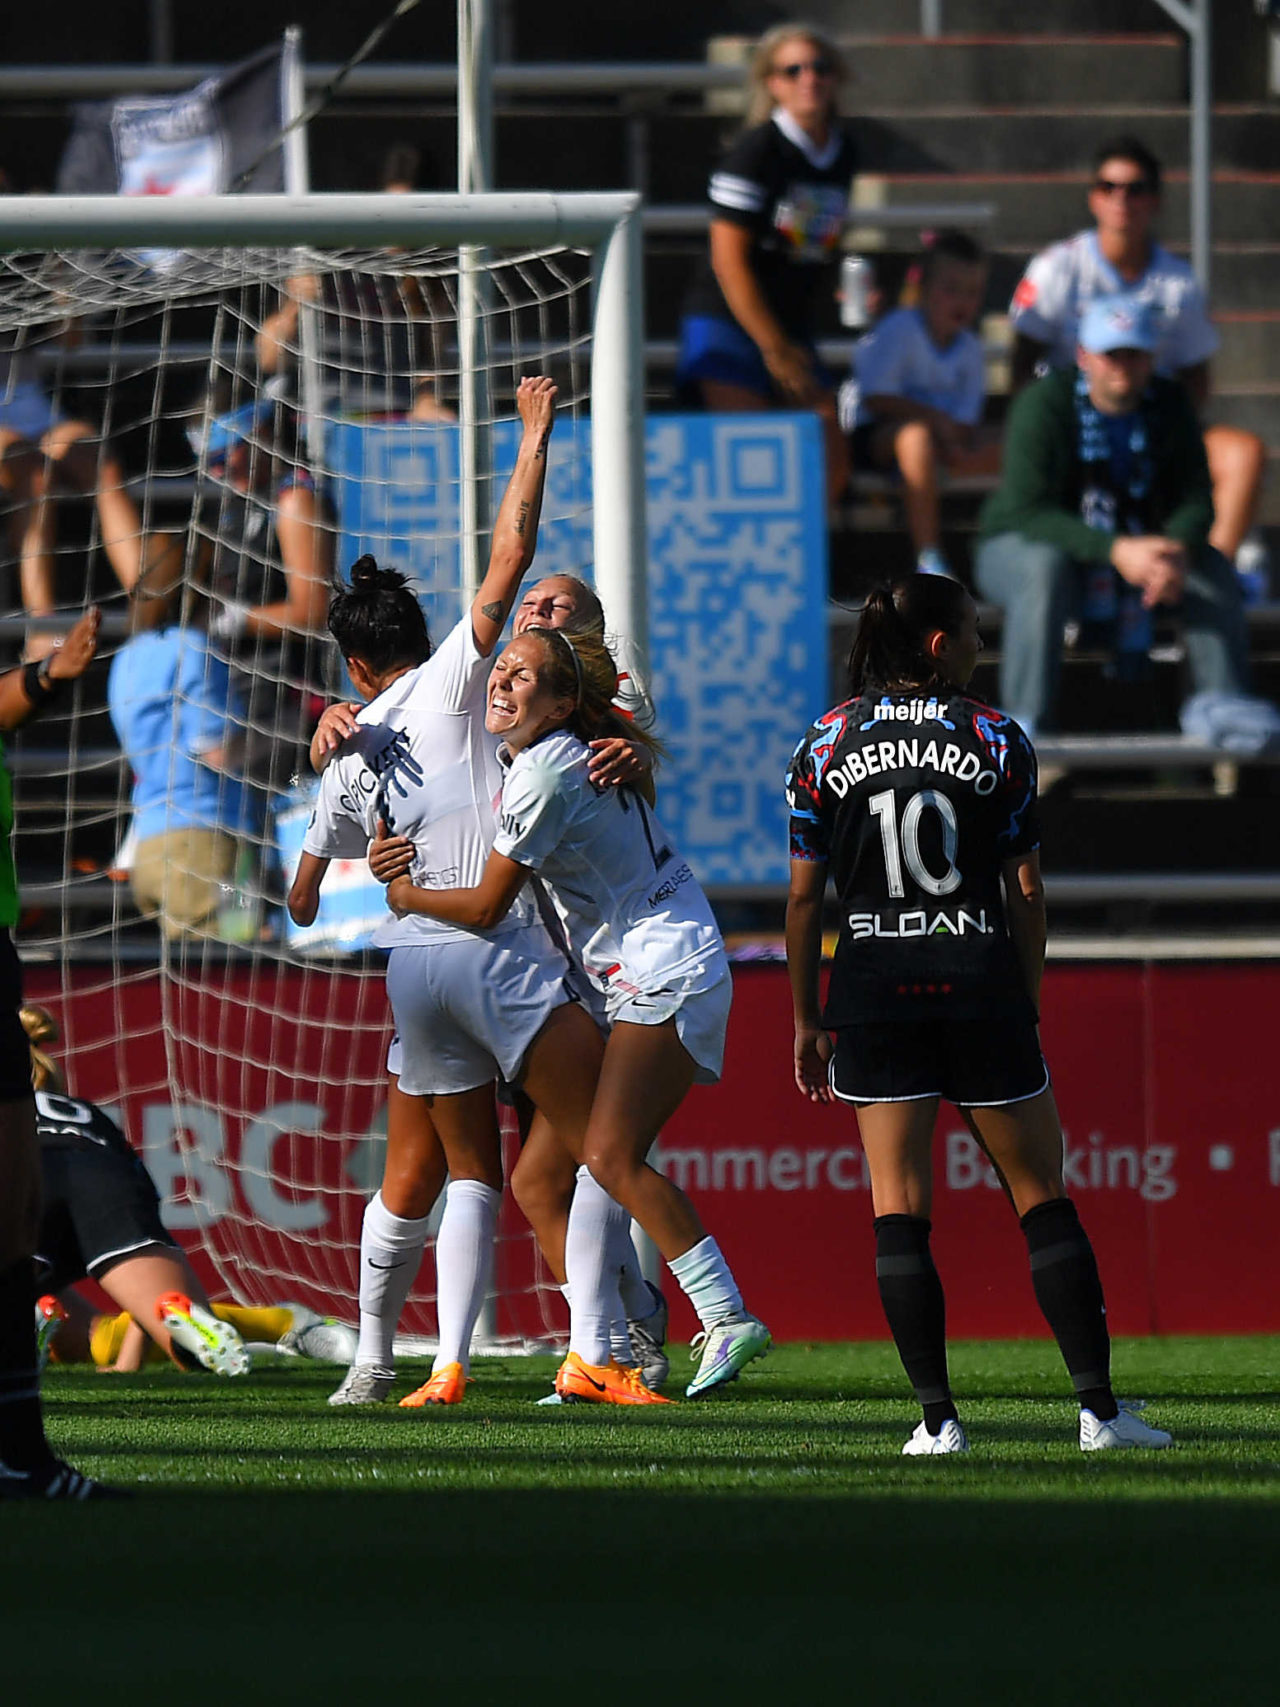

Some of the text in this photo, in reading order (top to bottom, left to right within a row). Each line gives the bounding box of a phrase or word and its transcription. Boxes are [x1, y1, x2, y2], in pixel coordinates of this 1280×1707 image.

[874, 699, 948, 725] meijer
[869, 788, 963, 899] 10
[102, 1102, 330, 1231] BC
[945, 1129, 1178, 1202] Bking
